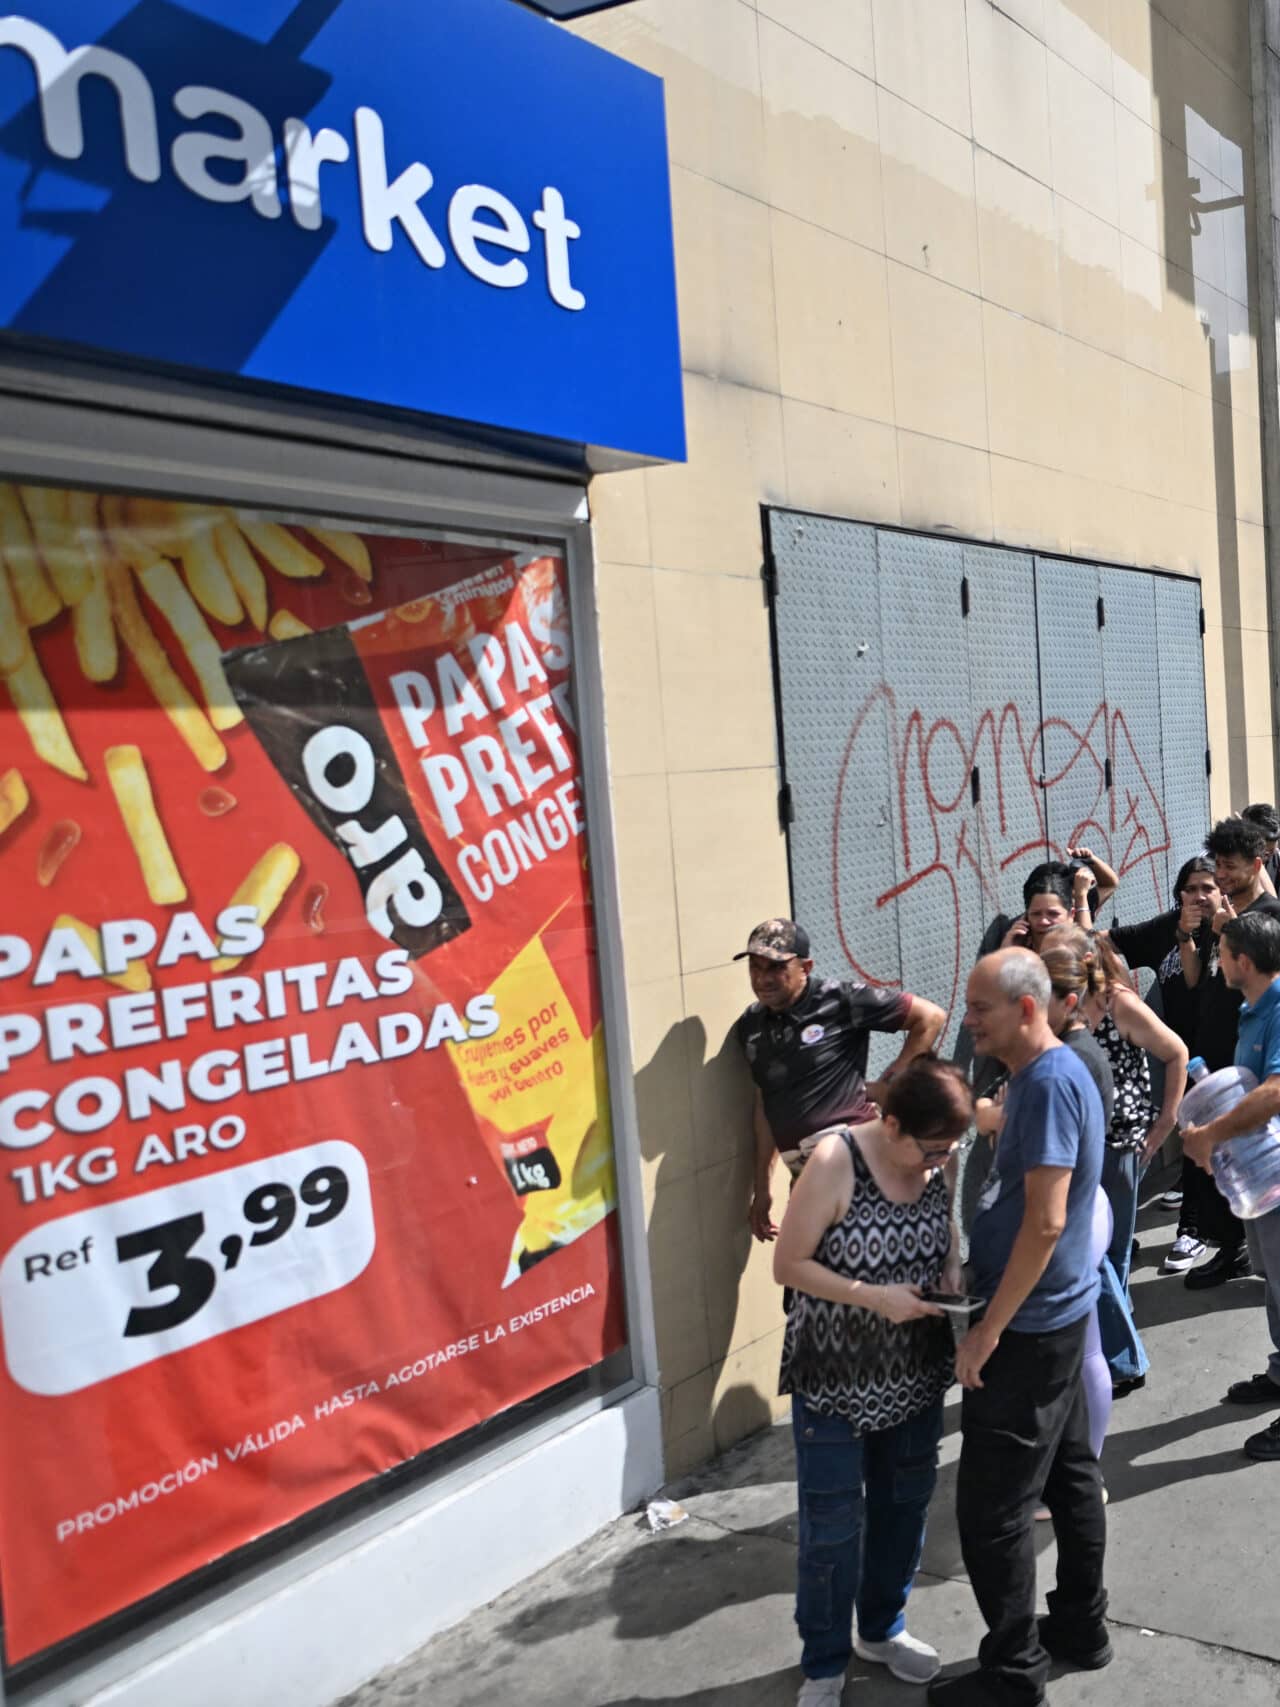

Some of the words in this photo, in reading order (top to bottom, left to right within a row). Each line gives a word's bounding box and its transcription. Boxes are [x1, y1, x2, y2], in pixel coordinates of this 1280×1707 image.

[0, 15, 586, 311] market
[389, 598, 571, 749] PAPAS
[0, 949, 414, 1072] PREFRITAS
[0, 994, 500, 1148] CONGELADAS
[509, 1027, 570, 1075] suaves
[528, 1002, 559, 1040] por
[12, 1147, 118, 1203] 1KG
[135, 1115, 247, 1173] ARO
[24, 1237, 94, 1282] Ref
[116, 1166, 349, 1337] 3,99
[56, 1454, 219, 1542] PROMOCIÓN
[224, 1415, 305, 1462] VÁLIDA
[314, 1380, 380, 1420] HASTA
[385, 1334, 480, 1389] AGOTARSE
[484, 1324, 506, 1345] LA
[509, 1283, 595, 1333] EXISTENCIA
